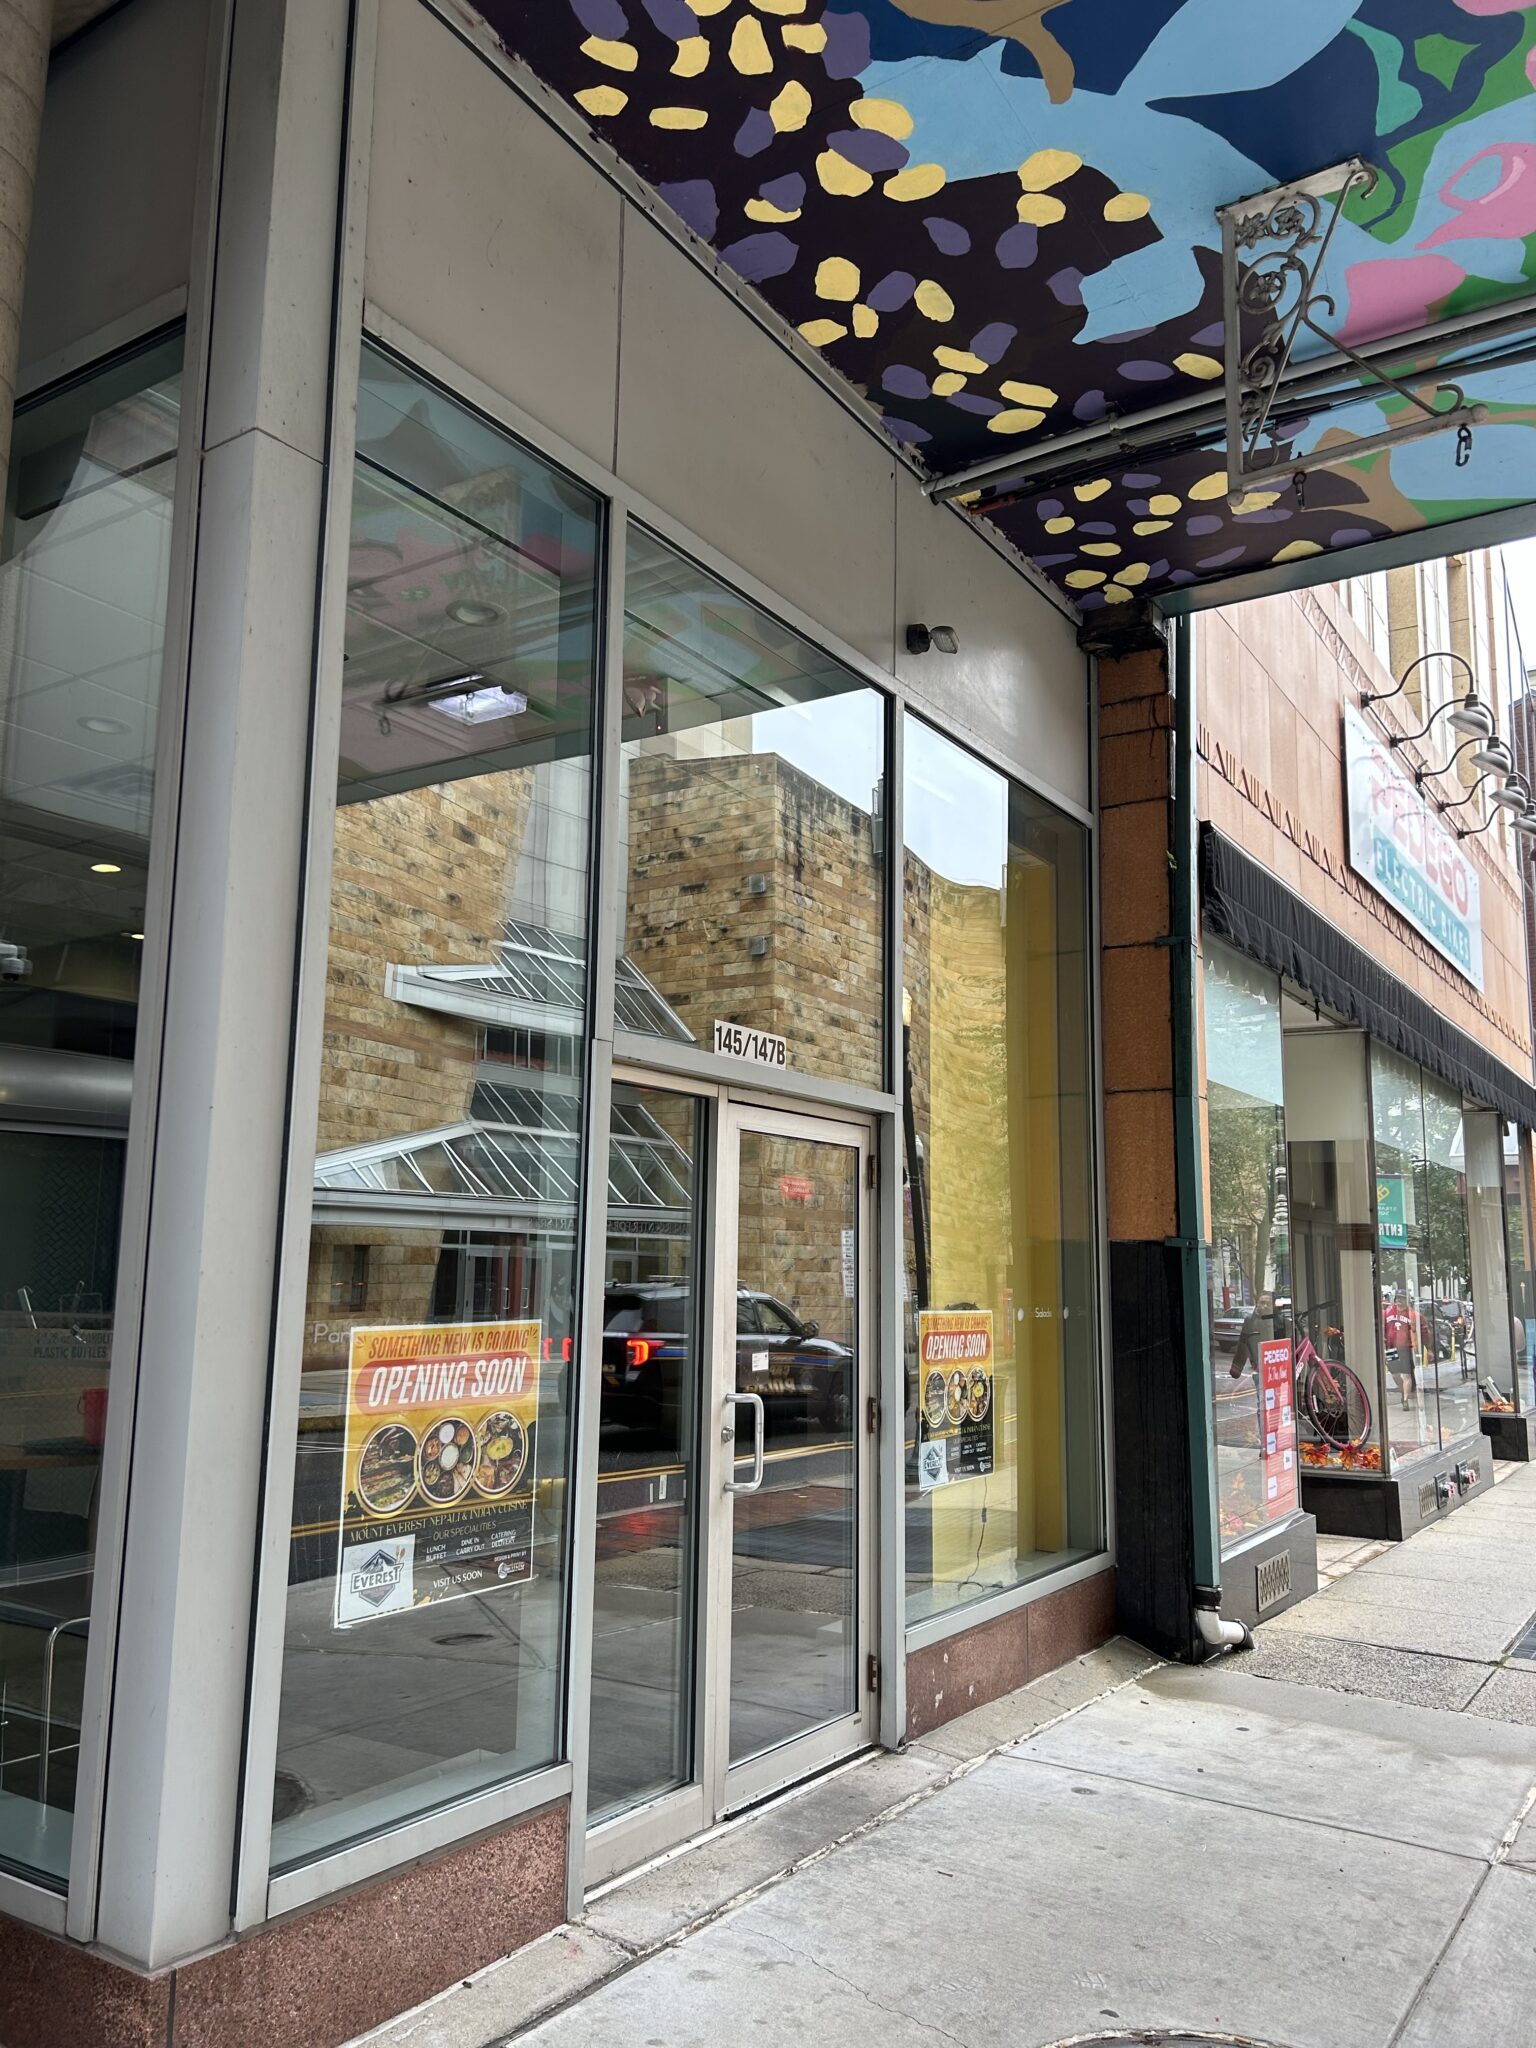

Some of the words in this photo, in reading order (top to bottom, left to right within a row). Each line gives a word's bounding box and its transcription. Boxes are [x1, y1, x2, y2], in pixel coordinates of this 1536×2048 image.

[1375, 838, 1437, 930] ELECTRIC
[1439, 912, 1471, 962] BIKES
[715, 1025, 786, 1066] 145/147B
[368, 1334, 441, 1359] SOMETHING
[442, 1332, 469, 1354] NEW
[471, 1331, 482, 1353] IS
[485, 1328, 529, 1351] COMING
[926, 1334, 965, 1360] OPENING
[965, 1333, 988, 1357] SOON
[1263, 1348, 1289, 1364] PEDEGO
[368, 1361, 468, 1409] OPENING
[470, 1356, 528, 1398] SOON
[349, 1526, 385, 1543] MOUNT
[386, 1518, 427, 1535] EVEREST
[430, 1512, 461, 1528] NEPALI
[461, 1513, 468, 1521] &
[469, 1505, 497, 1520] INDIAN
[432, 1527, 450, 1541] OUR
[450, 1520, 497, 1538] SPECIALITIES
[491, 1529, 517, 1540] CATERING
[426, 1544, 446, 1553] LUNCH
[456, 1546, 474, 1556] CARRY
[474, 1543, 485, 1551] OUT
[460, 1538, 474, 1547] DINE
[474, 1536, 480, 1544] IN
[425, 1552, 447, 1562] BUFFET
[353, 1566, 400, 1590] EVEREST
[433, 1576, 450, 1588] VISIT
[452, 1574, 462, 1585] US
[462, 1570, 483, 1582] SOON
